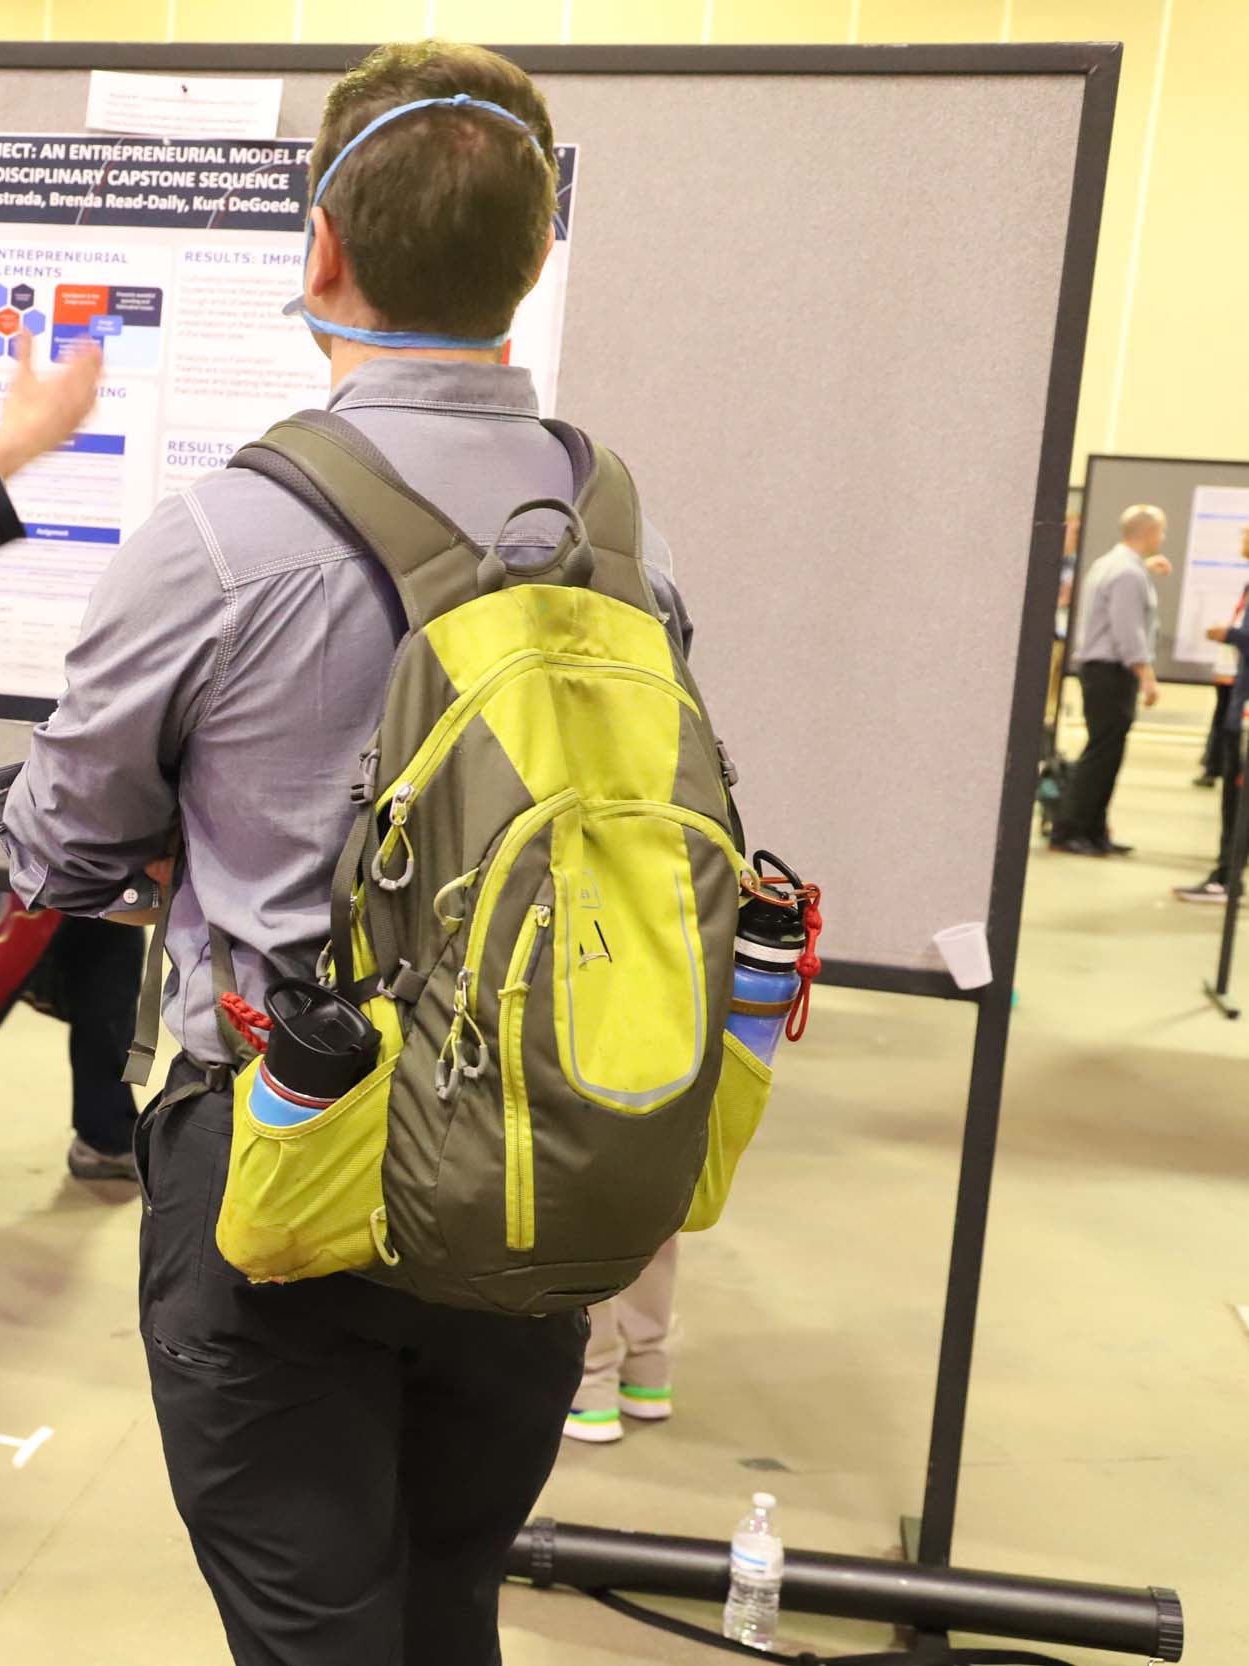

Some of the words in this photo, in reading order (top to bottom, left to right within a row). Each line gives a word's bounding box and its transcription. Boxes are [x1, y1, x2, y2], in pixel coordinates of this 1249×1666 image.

[40, 144, 67, 160] AN
[69, 144, 225, 164] ENTREPRENEURIAL
[229, 147, 292, 165] MODEL
[107, 169, 196, 188] CAPSTONE
[199, 171, 290, 190] SEQUENCE
[49, 192, 103, 209] Brenda
[105, 193, 189, 213] Read-Daily,
[193, 196, 225, 212] Kurt
[228, 197, 300, 214] DeGoede
[184, 250, 256, 265] RESULTS:
[262, 252, 303, 266] IMPR
[166, 454, 230, 468] OUTCOM
